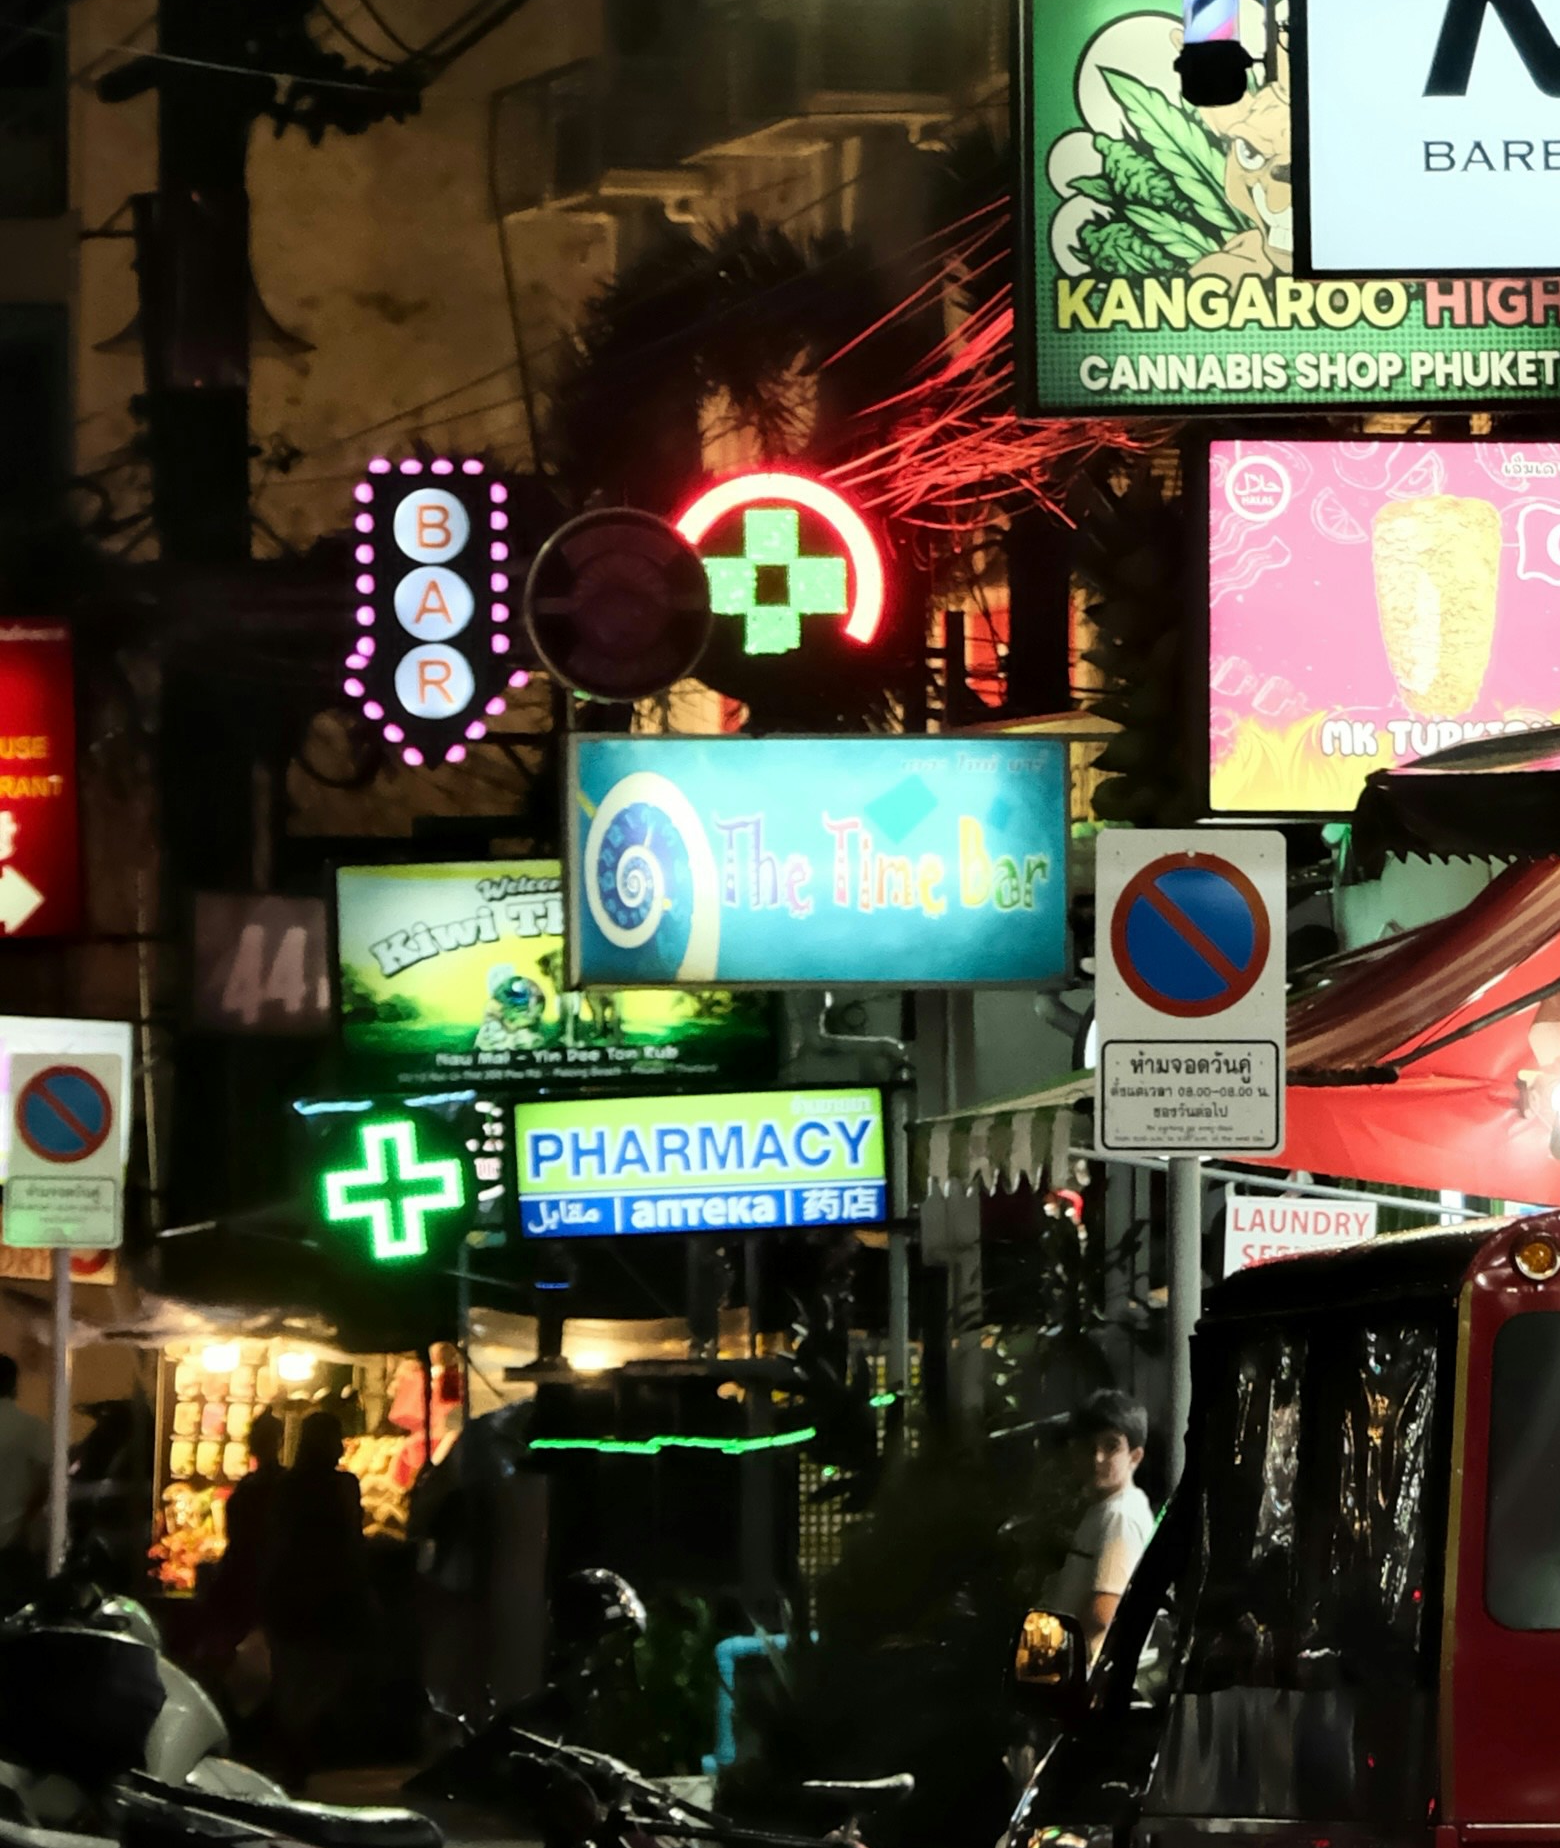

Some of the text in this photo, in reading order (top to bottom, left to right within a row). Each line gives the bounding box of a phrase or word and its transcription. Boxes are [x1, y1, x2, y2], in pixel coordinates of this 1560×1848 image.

[1057, 279, 1408, 329] KANGAROO
[1079, 354, 1287, 391] CANNABIS
[1302, 353, 1402, 389] SHOP
[413, 505, 455, 704] BAR
[1321, 719, 1378, 757] MK
[713, 810, 1050, 916] The Time Bar
[369, 905, 500, 979] Kiwi
[1130, 1050, 1252, 1084] ห้ามจอดวันคู่
[529, 1118, 873, 1179] PHARMACY
[630, 1194, 778, 1229] аптека
[802, 1187, 878, 1221] 药店
[1232, 1207, 1370, 1236] LAUNDRY
